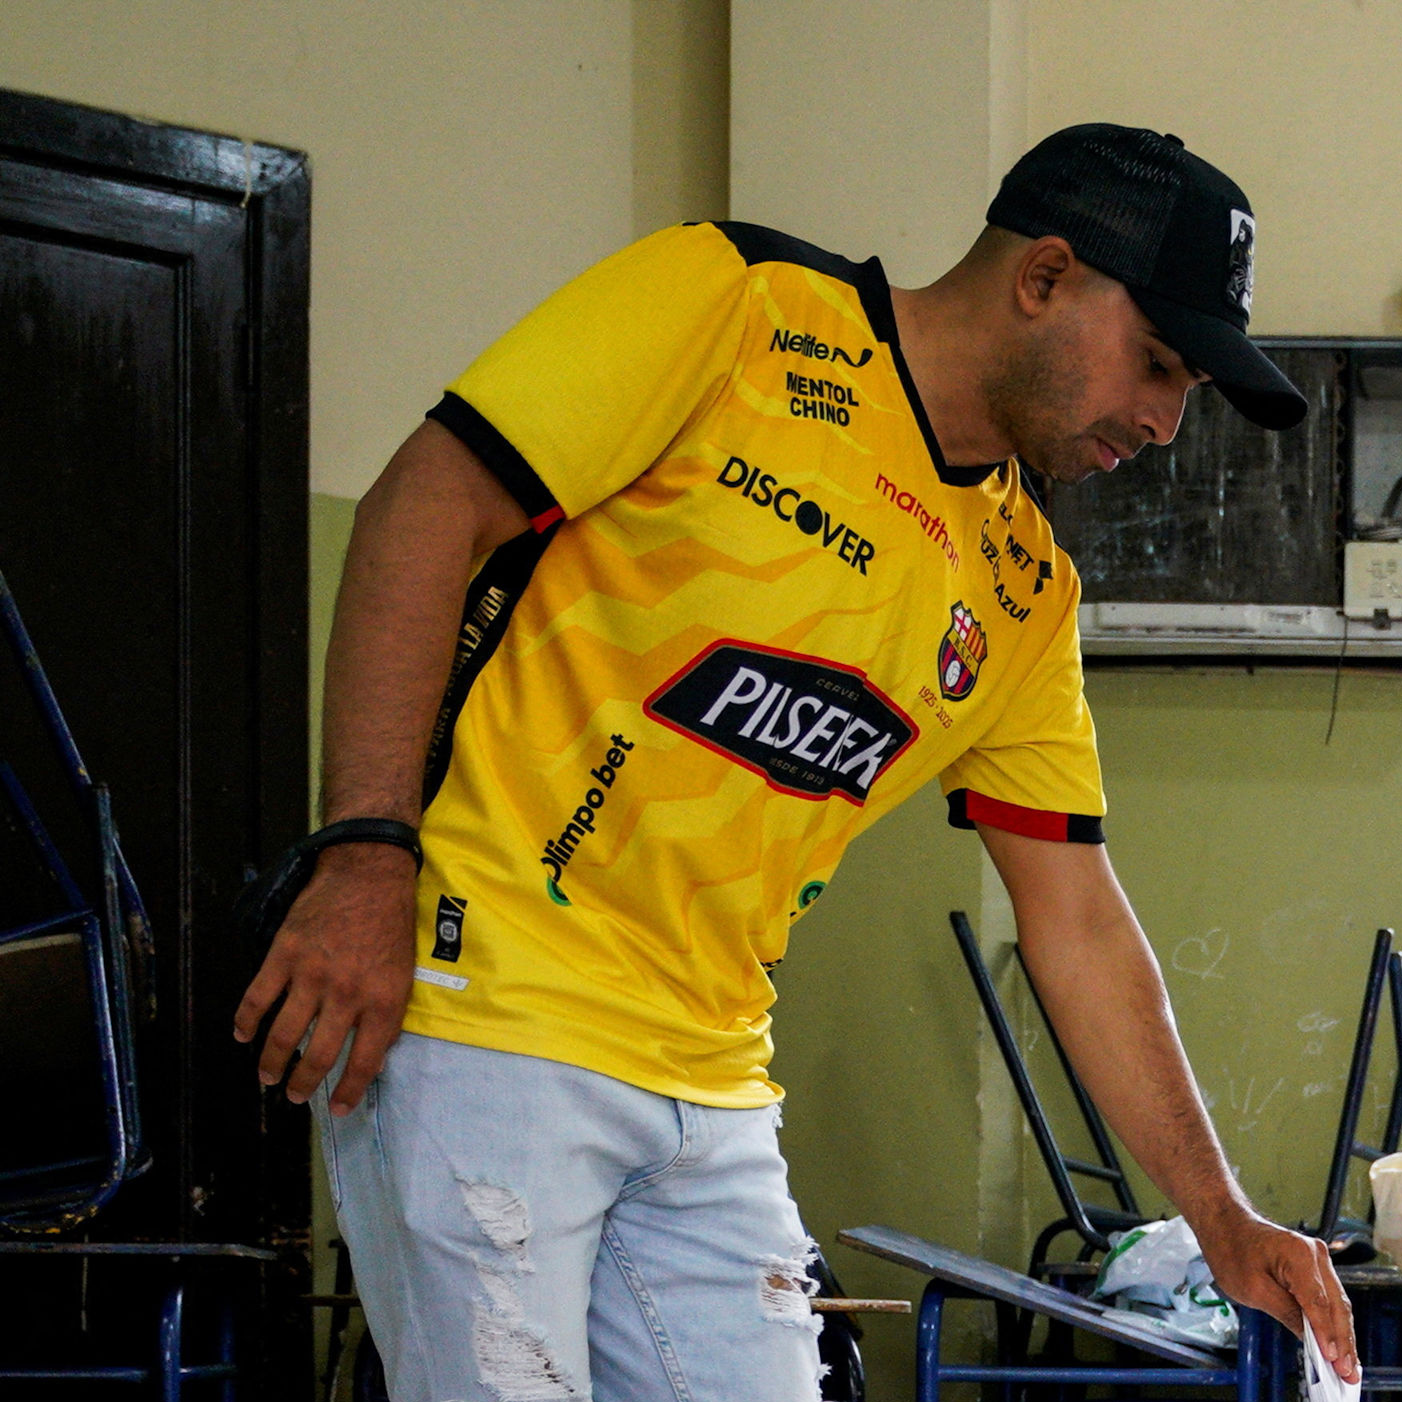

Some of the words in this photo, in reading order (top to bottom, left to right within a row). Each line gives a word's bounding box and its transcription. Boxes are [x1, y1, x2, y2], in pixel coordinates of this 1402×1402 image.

[786, 371, 859, 407] MENTOL
[790, 396, 850, 427] CHINO
[716, 455, 876, 577] DISCOVER
[874, 472, 960, 574] marathon
[590, 733, 635, 789] bet
